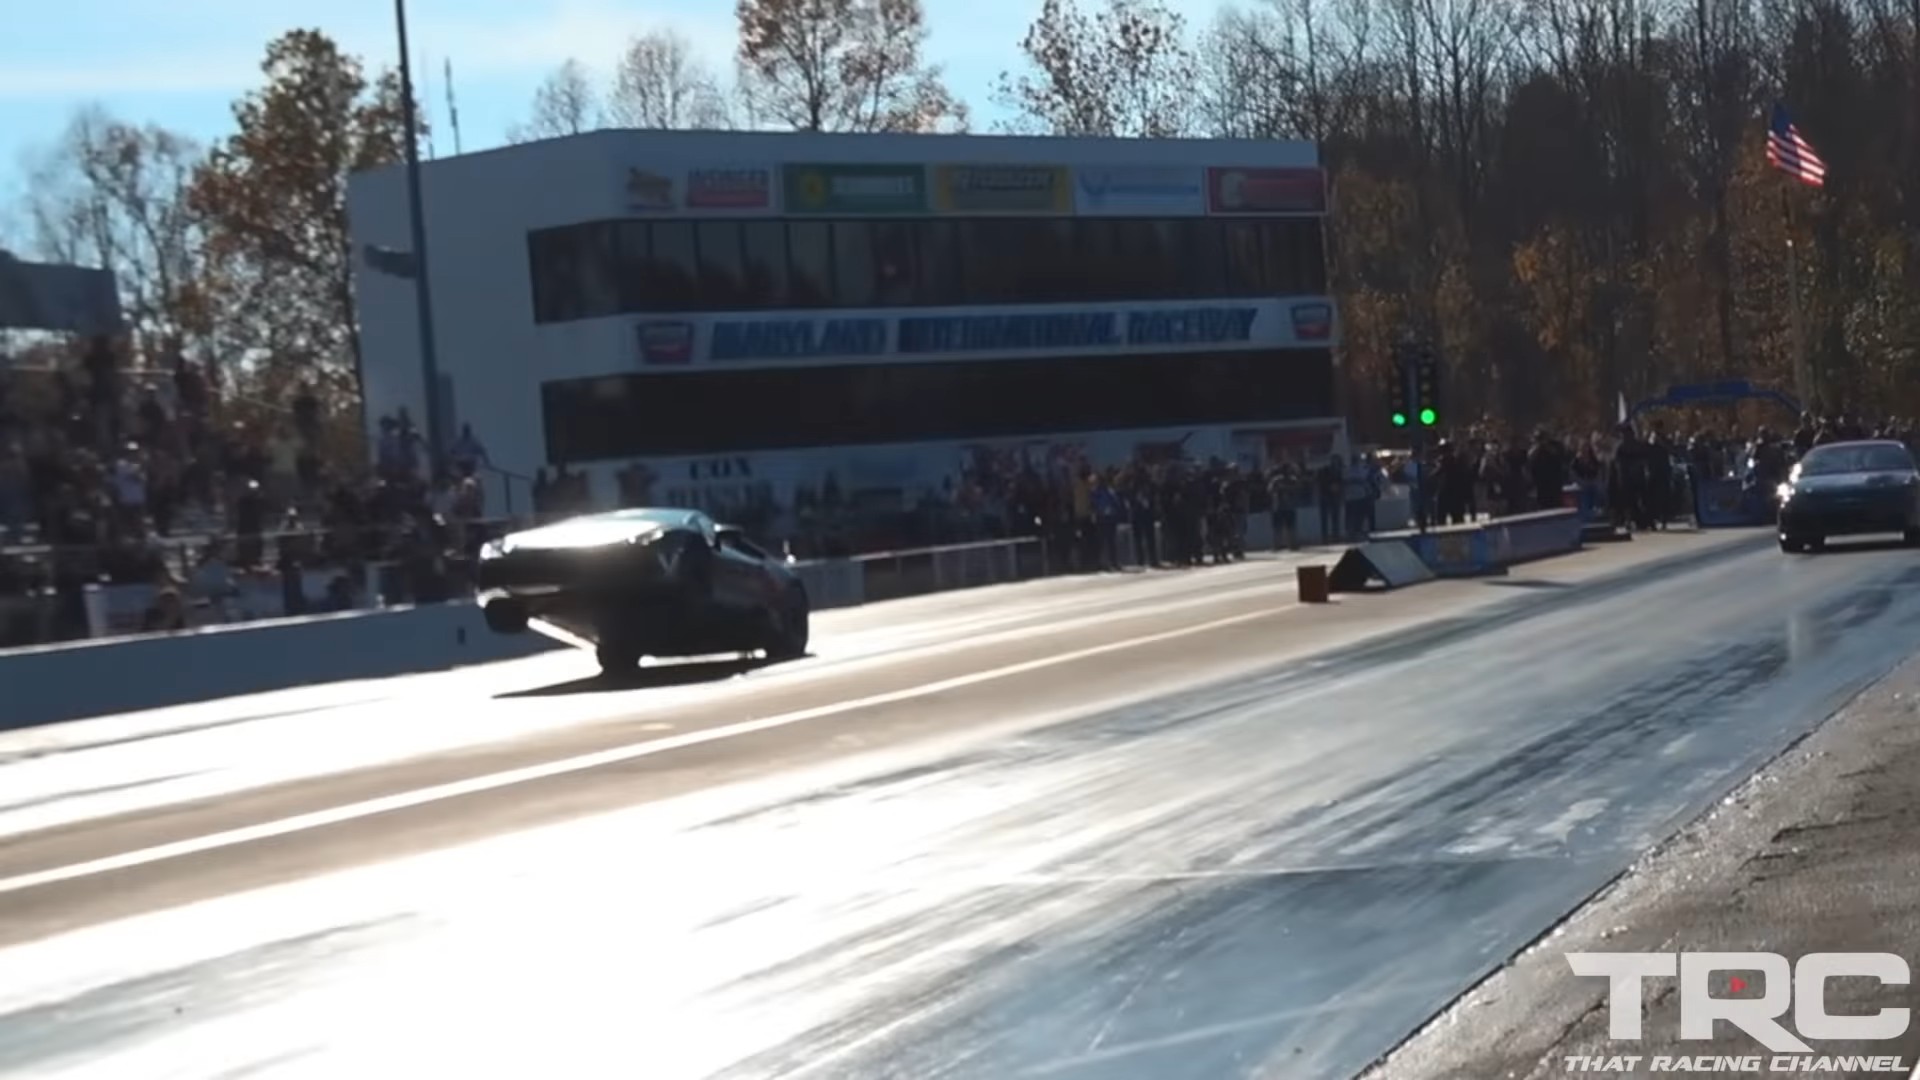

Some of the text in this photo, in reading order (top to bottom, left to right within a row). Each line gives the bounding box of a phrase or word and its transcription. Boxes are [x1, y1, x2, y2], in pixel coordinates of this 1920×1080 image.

[710, 318, 886, 360] MARYLAND
[898, 311, 1119, 353] INTERNATIONAL
[1127, 307, 1257, 344] RACEWAY
